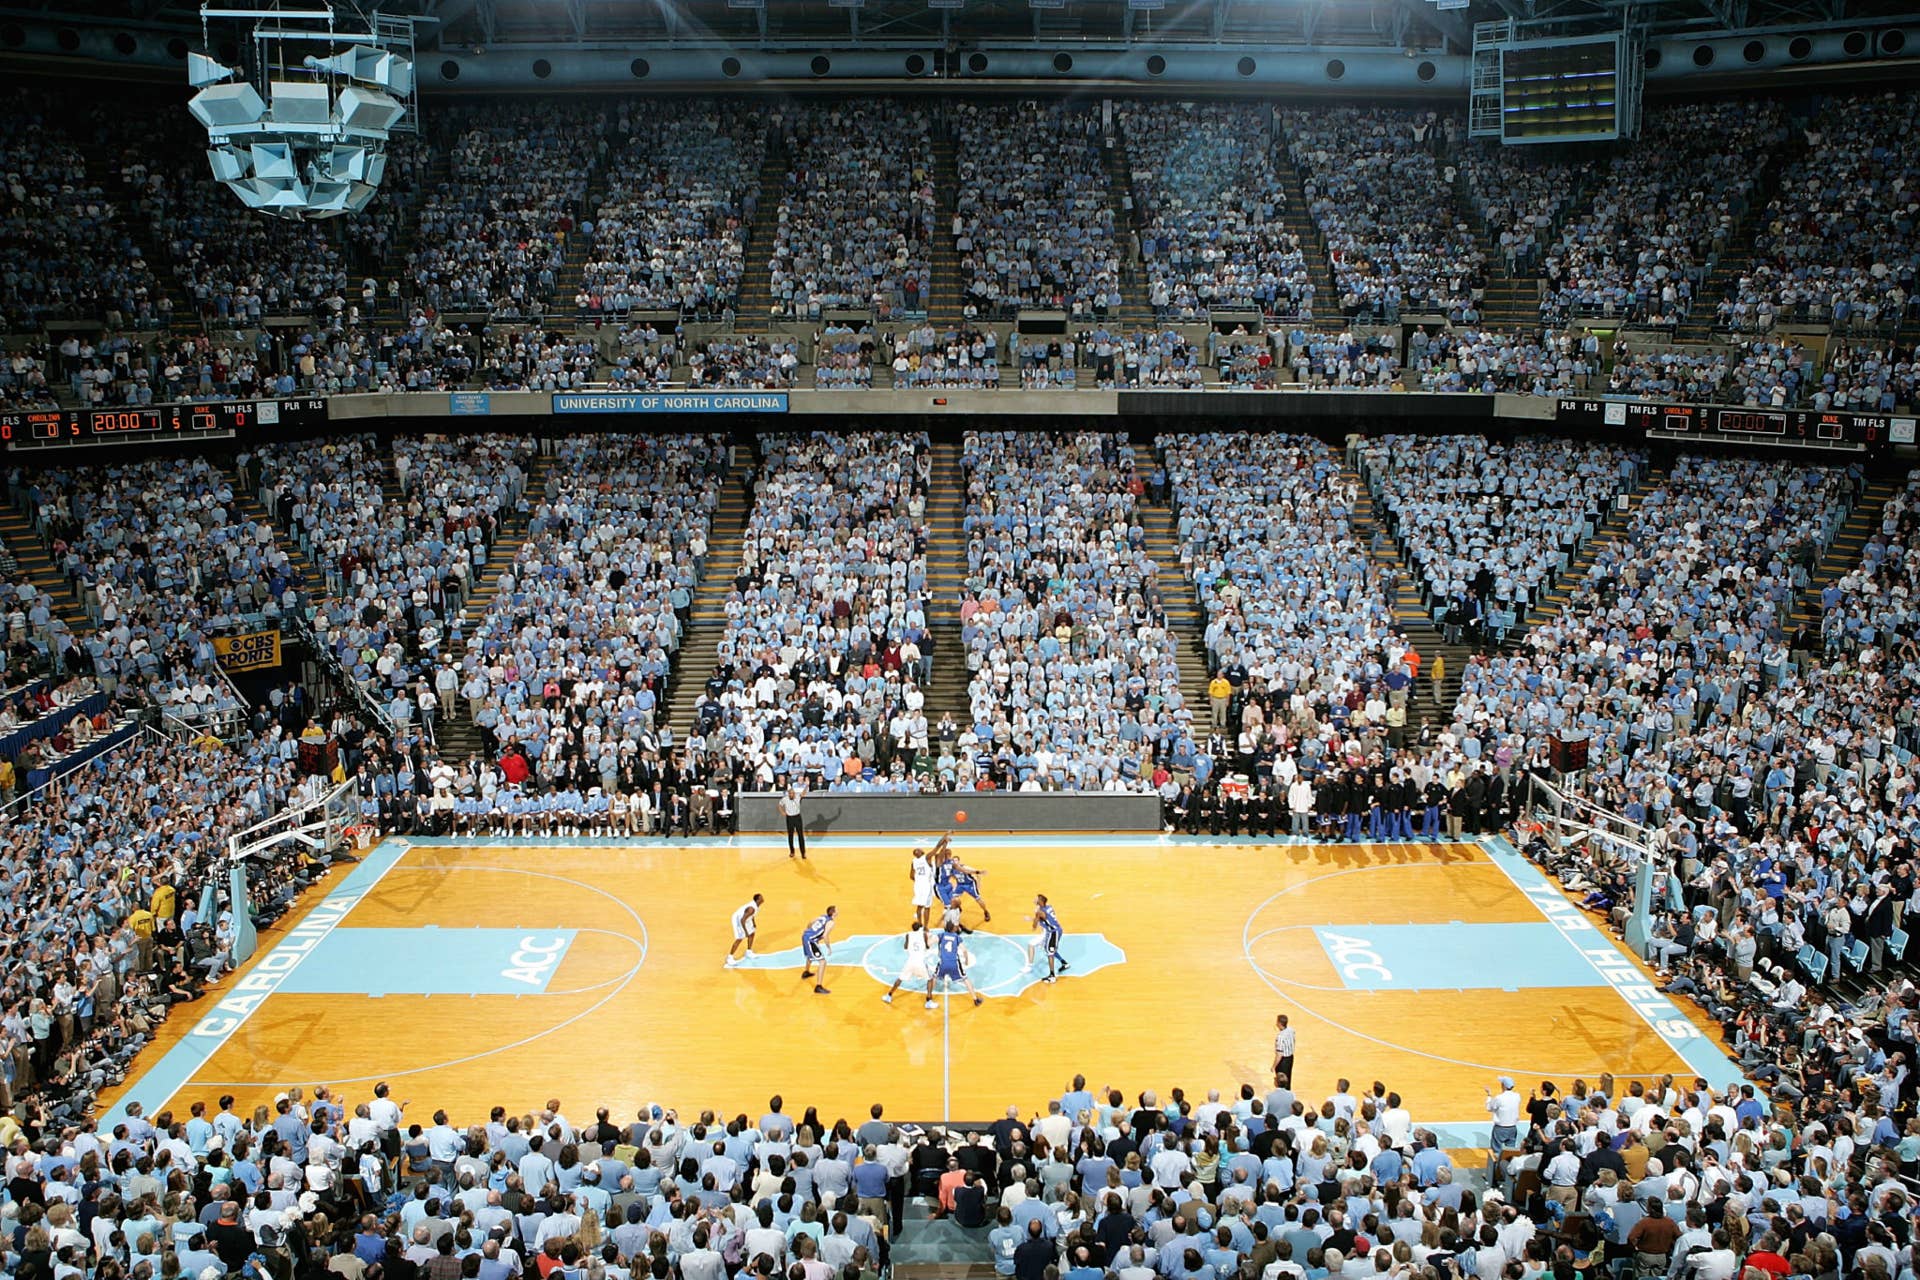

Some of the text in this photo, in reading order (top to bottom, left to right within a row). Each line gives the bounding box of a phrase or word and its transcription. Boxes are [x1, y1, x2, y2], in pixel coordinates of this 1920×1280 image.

[284, 401, 323, 411] PLR FLS
[561, 398, 780, 408] UNIVERSITY OF NORTH CAROLINA
[1561, 401, 1598, 411] PLR FLS
[224, 405, 252, 414] TM FLS
[1629, 406, 1657, 415] TM FLS
[3, 416, 20, 425] FLS
[95, 413, 140, 431] 20:00
[172, 417, 180, 429] 5
[206, 414, 214, 428] 0
[236, 413, 245, 426] 0
[1822, 415, 1838, 423] DUKE
[1853, 418, 1885, 428] TM FLS
[1, 425, 12, 439] 0
[48, 424, 57, 437] 0
[71, 423, 80, 435] 5
[244, 634, 274, 650] CBS
[501, 936, 566, 984] ACC
[1320, 930, 1393, 981] ACC
[1526, 883, 1700, 1038] TAR HEELS
[193, 893, 358, 1036] CAROLINA
